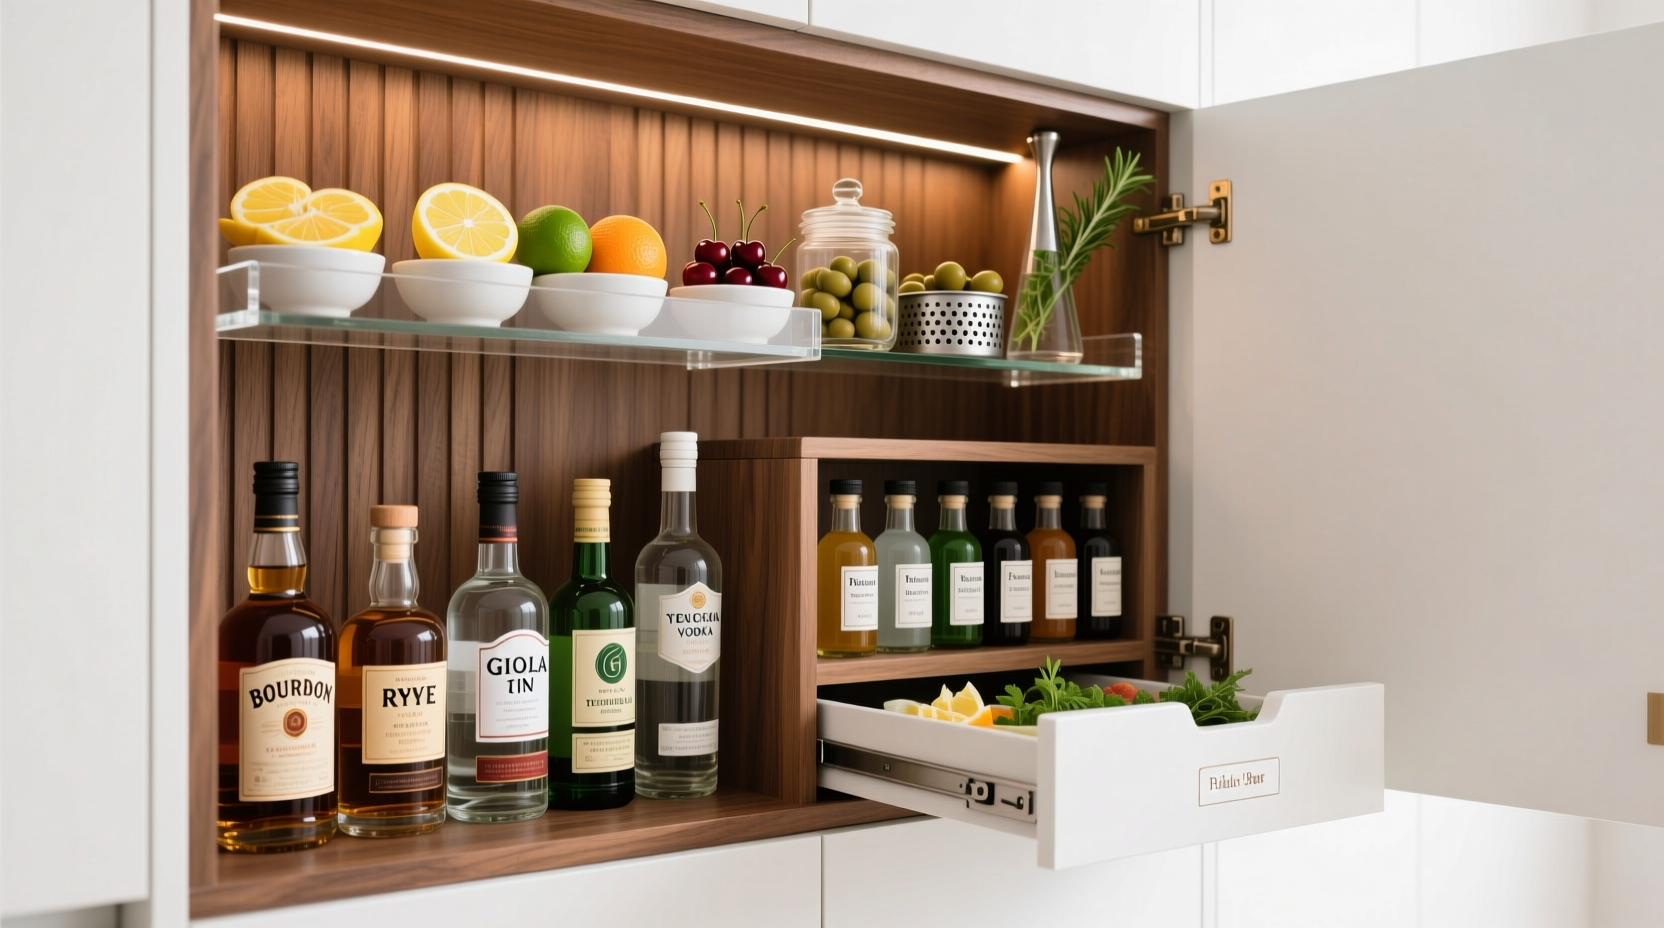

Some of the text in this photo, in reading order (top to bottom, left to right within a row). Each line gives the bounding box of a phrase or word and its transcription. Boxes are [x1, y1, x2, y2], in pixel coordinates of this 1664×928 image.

[677, 626, 714, 637] VODKA
[486, 656, 547, 675] GIOLA
[249, 678, 333, 709] BOURDON
[382, 685, 437, 708] RYYE
